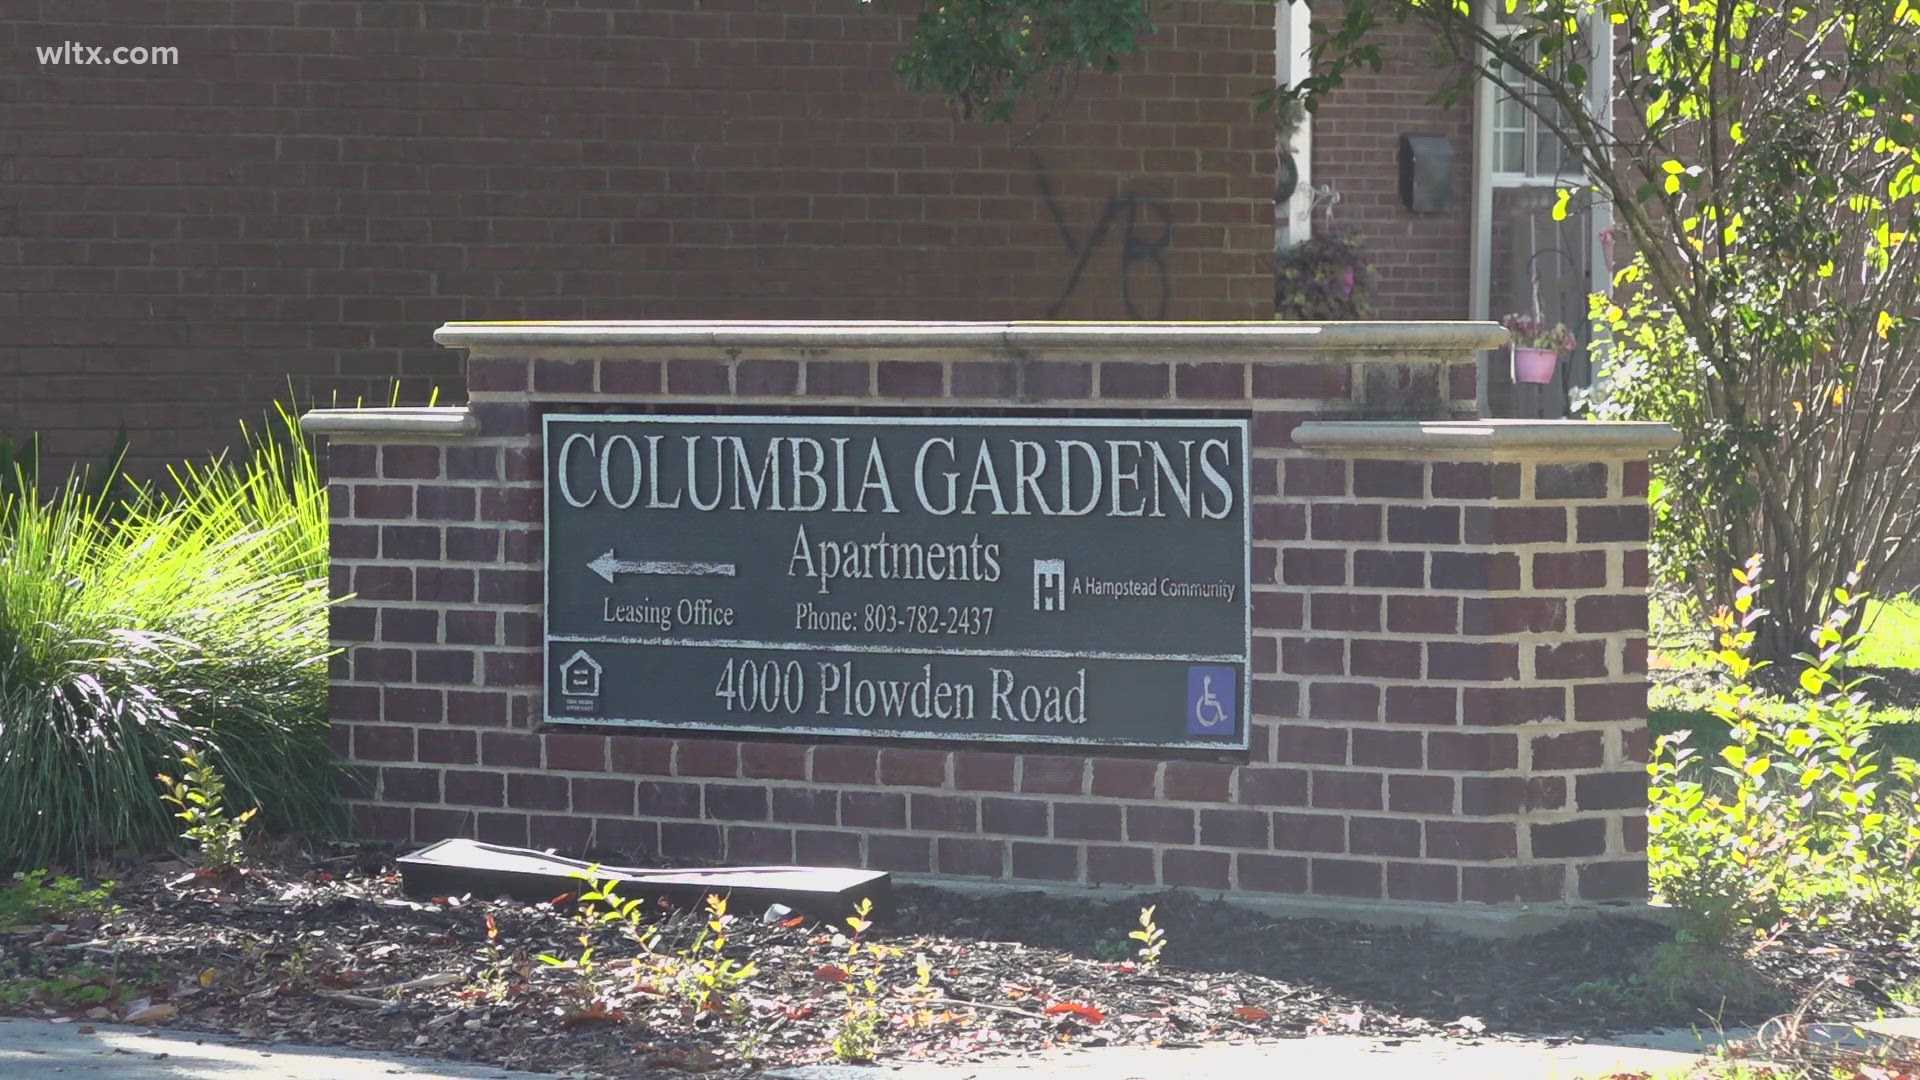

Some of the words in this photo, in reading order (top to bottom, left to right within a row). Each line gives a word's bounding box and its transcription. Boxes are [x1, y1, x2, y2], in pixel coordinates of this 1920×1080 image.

[558, 432, 900, 514] COLUMBIA
[914, 437, 1234, 521] GARDENS
[787, 523, 1001, 594] Apartments
[603, 597, 672, 631] Leasing
[677, 598, 734, 626] Office
[1072, 577, 1082, 595] A
[1085, 577, 1157, 600] Hampstead
[1160, 577, 1235, 603] Community
[795, 602, 857, 631] Phone:
[864, 603, 993, 636] 803-782-2437
[715, 657, 804, 714] 4000
[816, 660, 975, 721] Plowden
[989, 667, 1088, 725] Road
